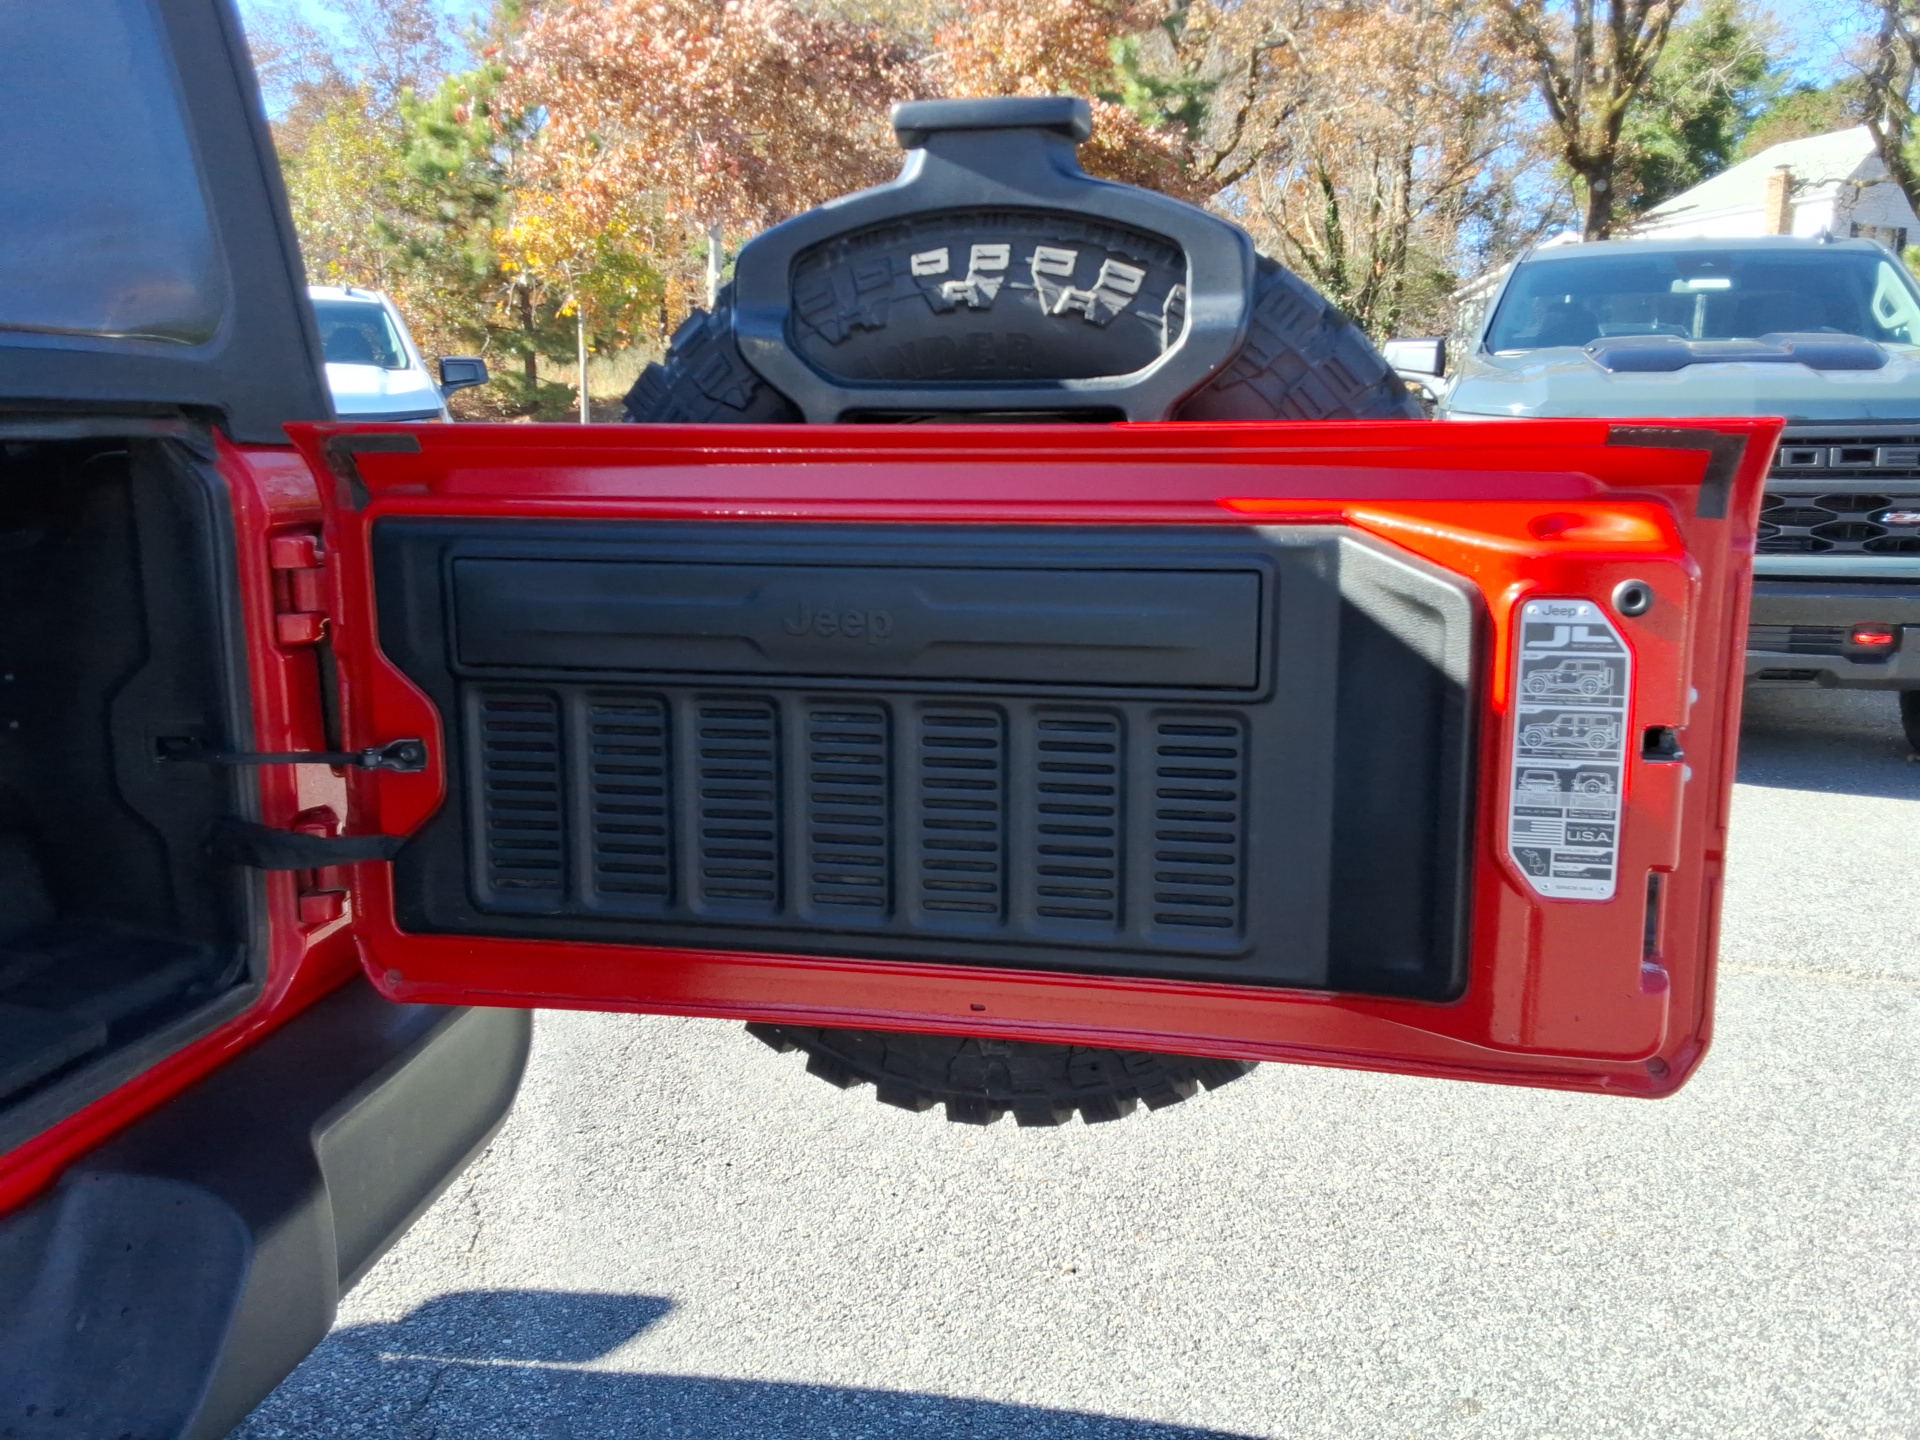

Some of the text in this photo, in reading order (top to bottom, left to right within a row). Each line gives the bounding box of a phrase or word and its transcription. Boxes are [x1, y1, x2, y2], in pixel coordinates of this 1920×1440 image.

[1542, 605, 1576, 618] Jeep
[783, 602, 894, 645] Jeep
[1526, 626, 1613, 647] JL
